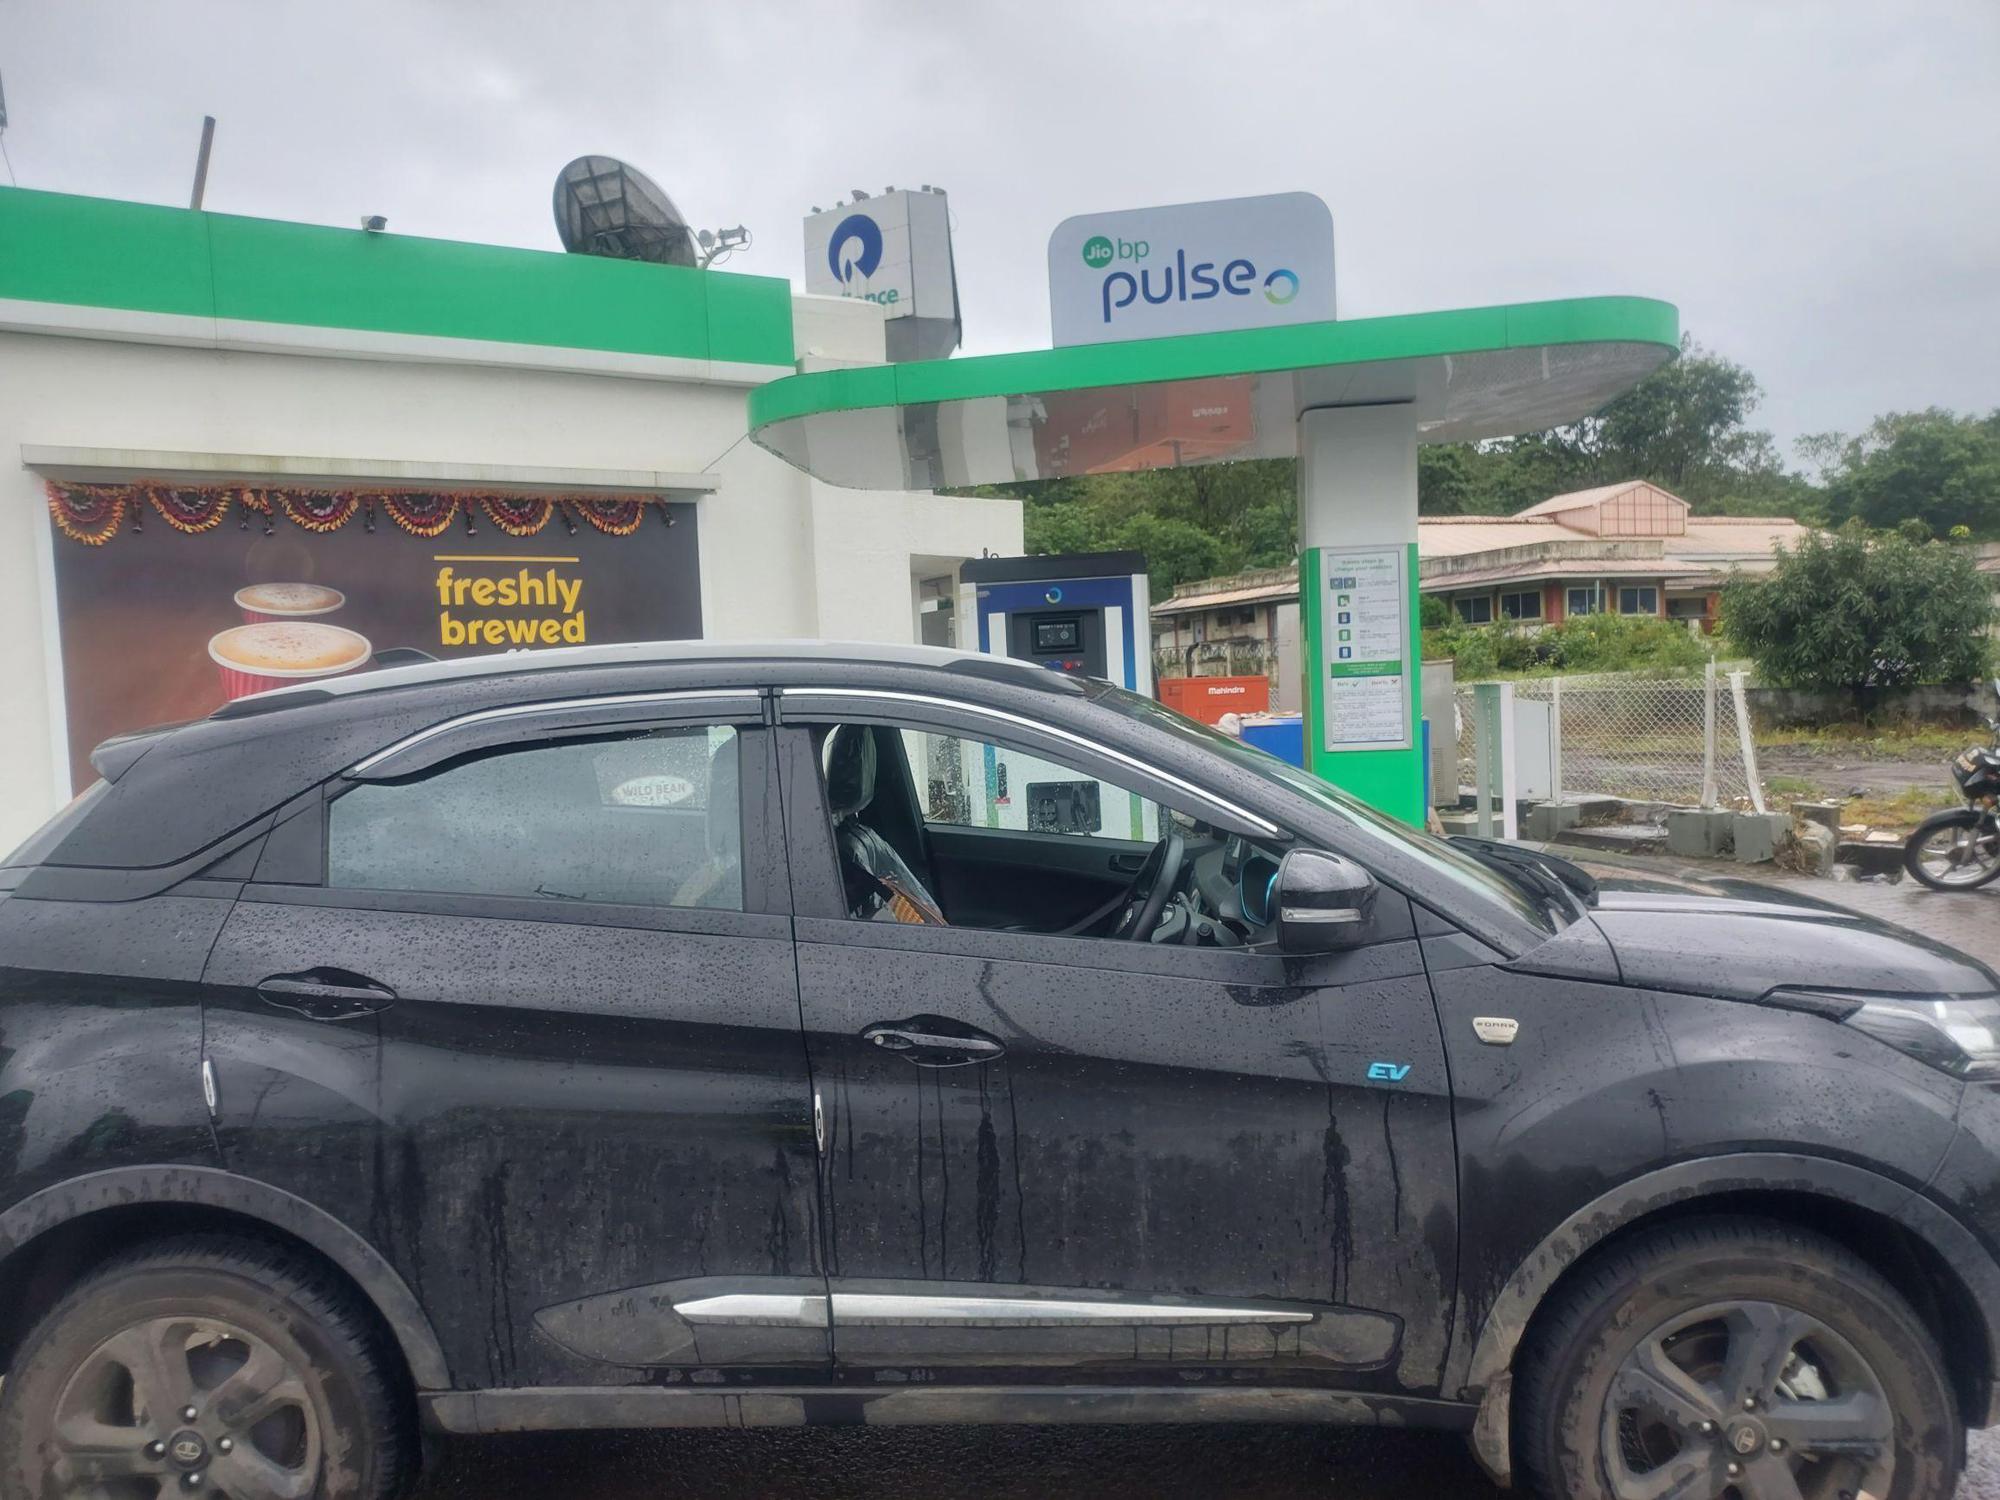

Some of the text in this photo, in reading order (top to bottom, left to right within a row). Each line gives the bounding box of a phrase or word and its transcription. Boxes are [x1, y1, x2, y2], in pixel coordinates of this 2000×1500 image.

[1086, 238, 1150, 263] Jio bp
[1102, 249, 1257, 323] pulse
[436, 567, 583, 613] freshly
[440, 610, 586, 645] brewed
[622, 782, 687, 797] WILD BEAN
[1367, 1062, 1411, 1081] EV
